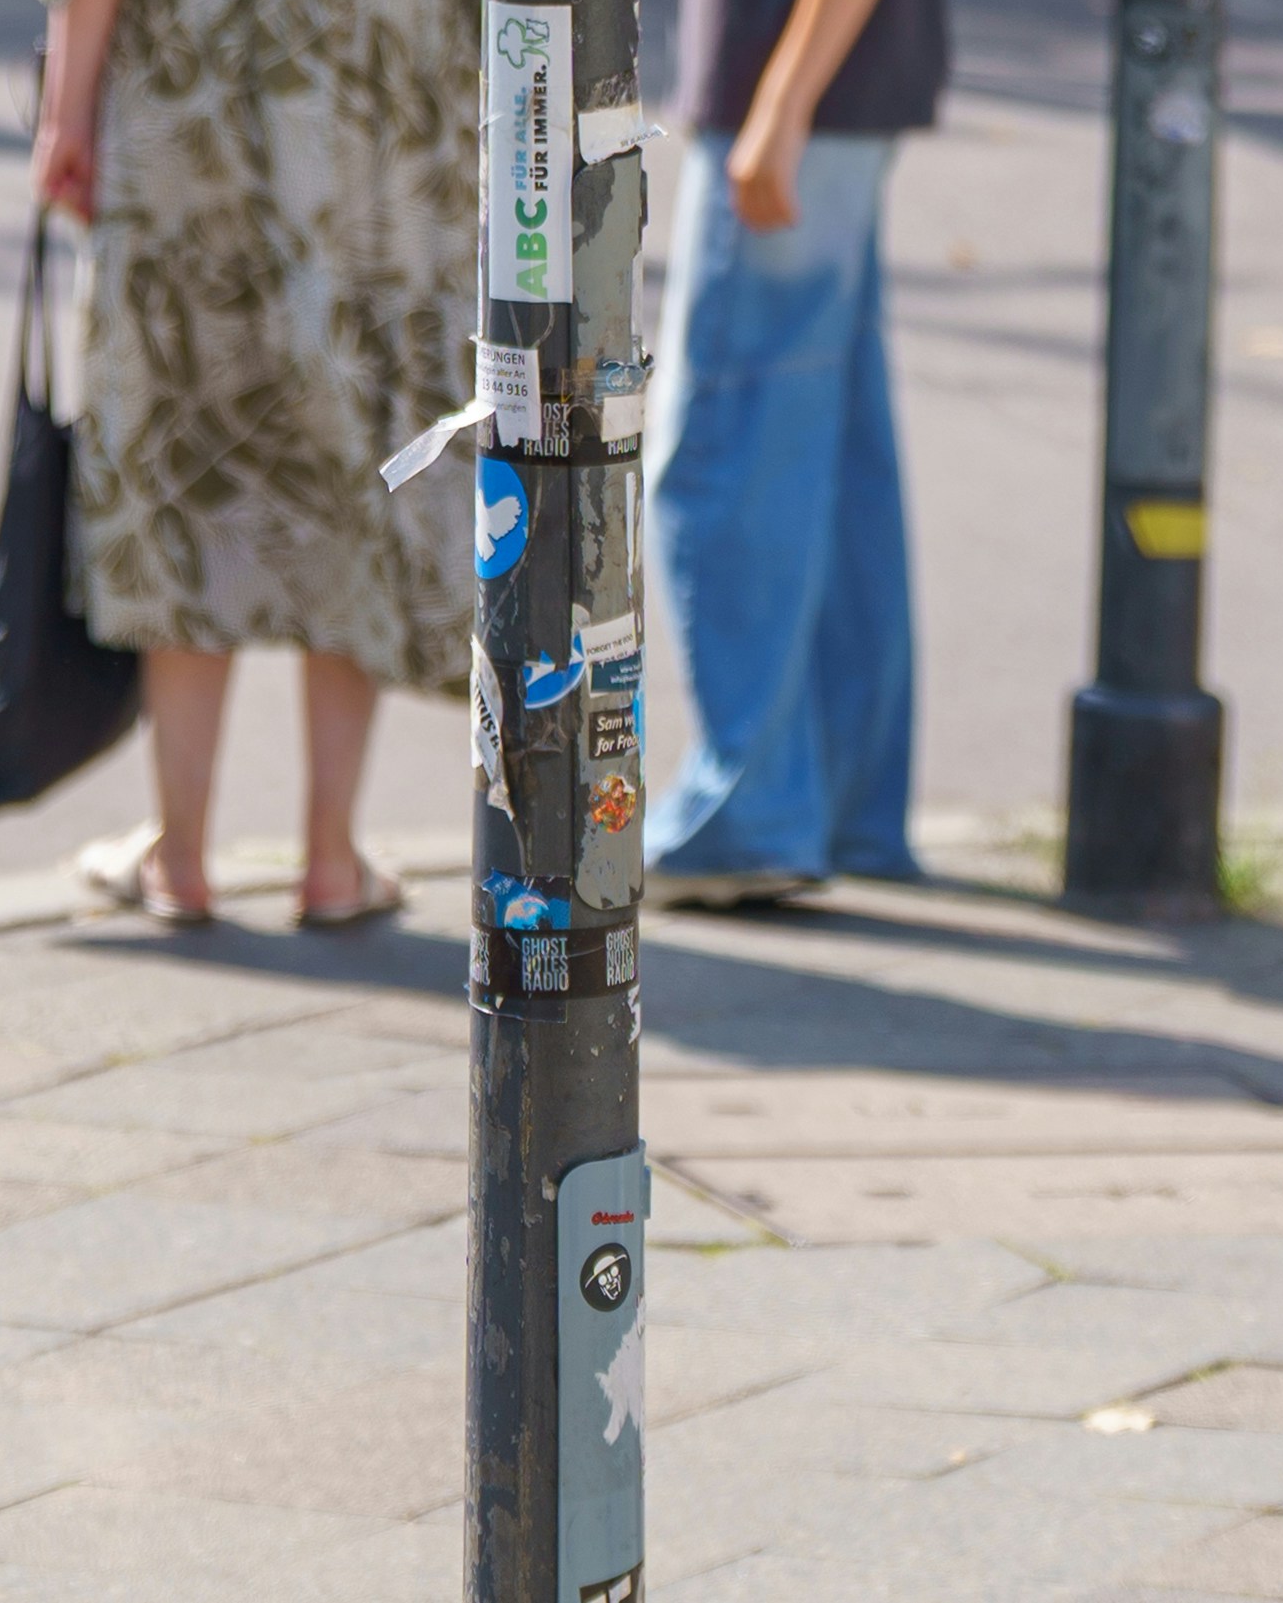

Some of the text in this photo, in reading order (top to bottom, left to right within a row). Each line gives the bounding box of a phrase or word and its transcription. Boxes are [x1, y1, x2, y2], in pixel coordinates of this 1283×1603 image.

[511, 86, 528, 190] FÜR ALLE.
[529, 64, 549, 192] FÜR IMMER.
[515, 196, 549, 299] ABC
[506, 384, 528, 397] 916
[523, 437, 569, 457] RADIO
[596, 715, 623, 732] Sam
[594, 737, 615, 757] for
[521, 937, 568, 956] GHOST
[521, 955, 569, 974] NOTES
[521, 972, 570, 992] RADIO
[606, 964, 635, 987] RADIO
